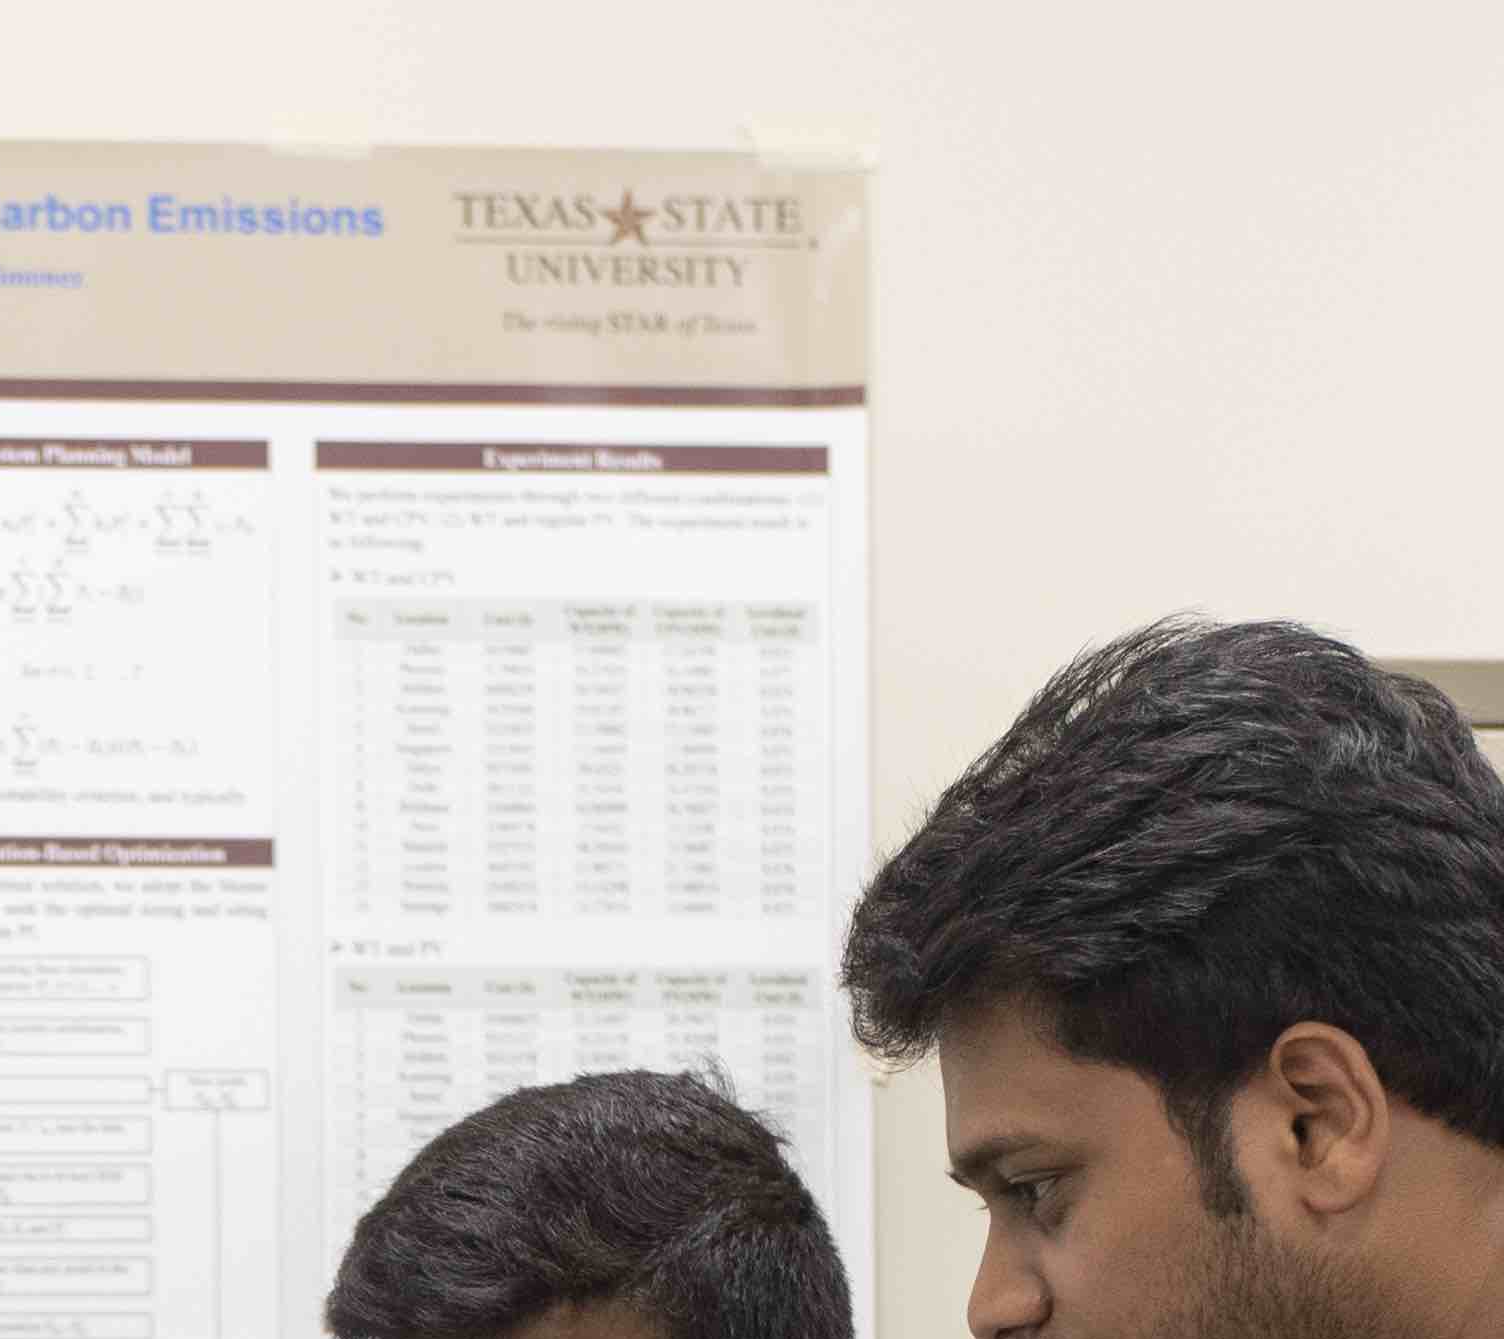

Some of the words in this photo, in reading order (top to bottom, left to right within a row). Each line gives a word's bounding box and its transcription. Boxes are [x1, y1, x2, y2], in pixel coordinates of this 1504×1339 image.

[148, 193, 384, 237] Emissions
[455, 192, 596, 230] TEXAS
[661, 195, 803, 233] STATE
[505, 254, 745, 287] UNIVERSITY
[607, 313, 668, 333] STAR
[43, 443, 126, 465] Planning
[132, 444, 191, 466] Model
